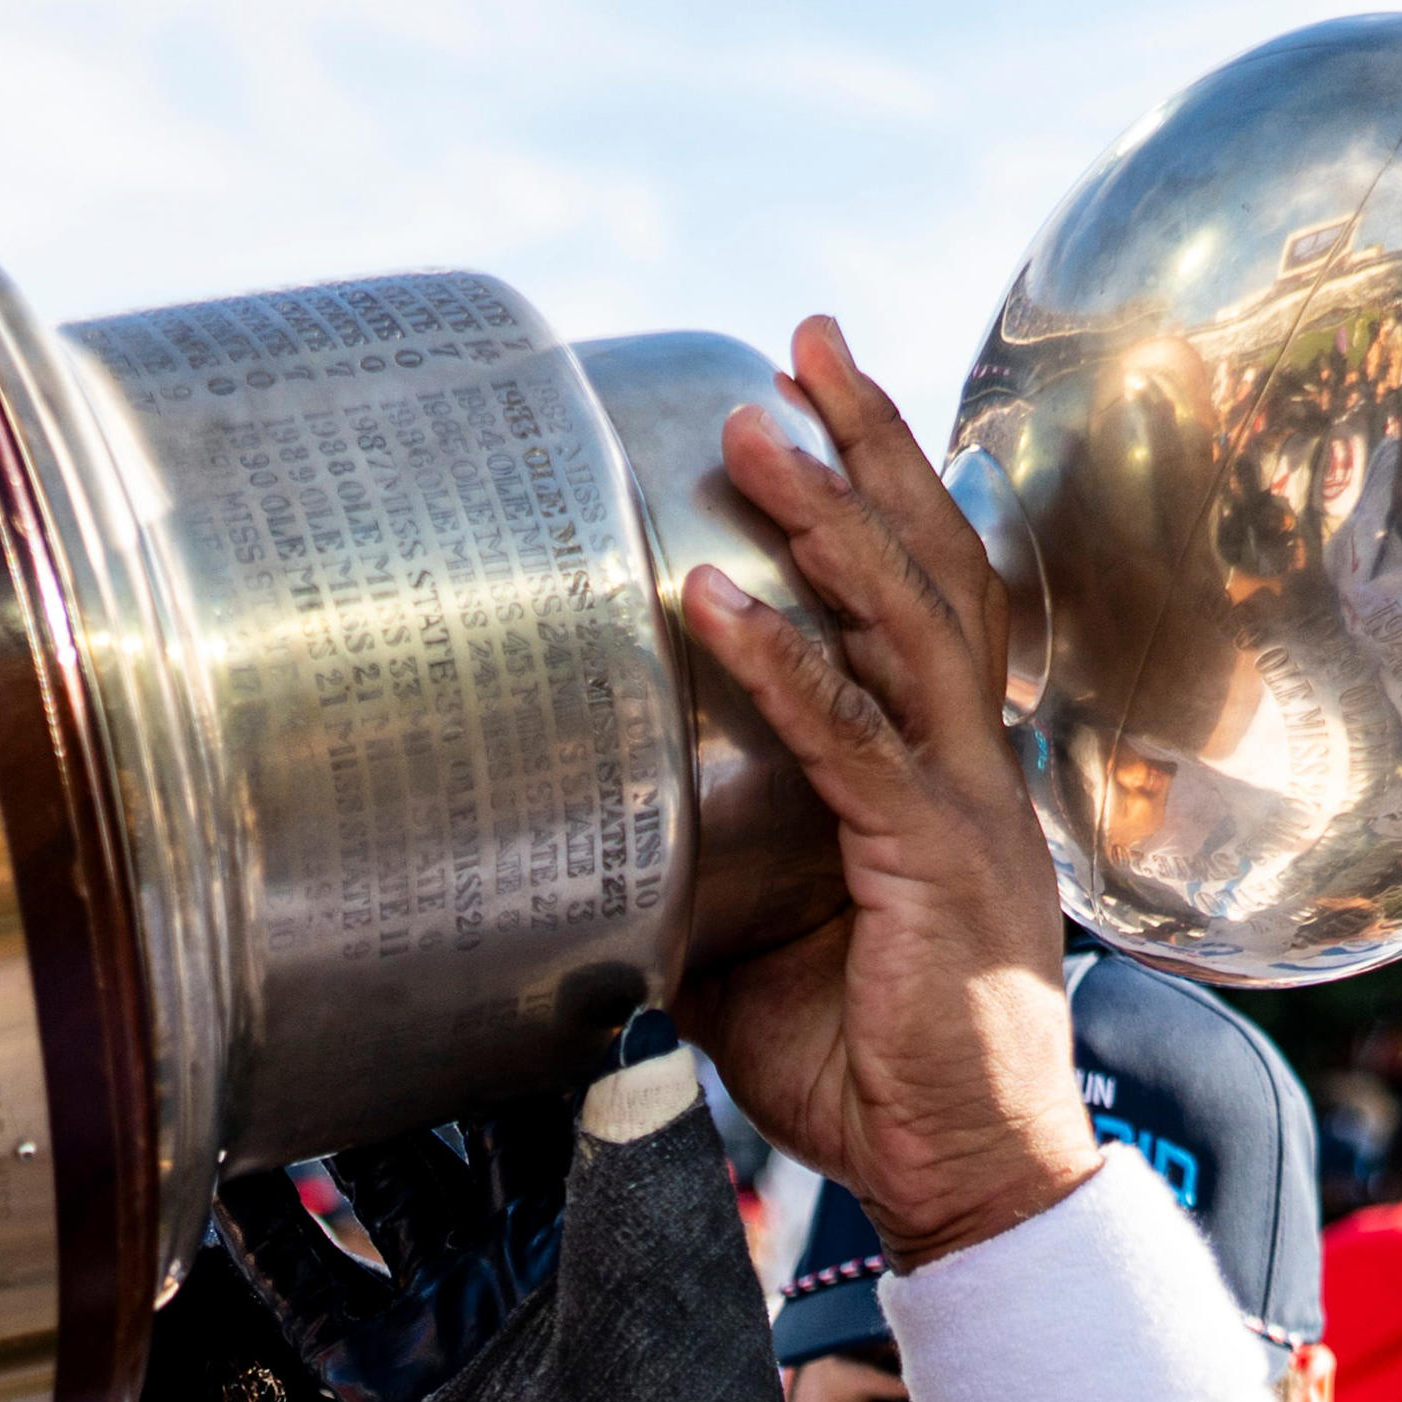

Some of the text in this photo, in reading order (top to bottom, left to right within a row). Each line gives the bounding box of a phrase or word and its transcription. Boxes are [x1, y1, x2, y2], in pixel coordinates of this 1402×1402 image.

[243, 371, 277, 389] 0
[323, 364, 356, 381] 7
[357, 356, 387, 372] 0
[392, 350, 425, 367] 0
[427, 345, 462, 363] 7
[500, 338, 534, 355] 7
[204, 377, 239, 395] 0
[216, 490, 266, 565] MISS
[302, 410, 357, 477] 1988
[335, 478, 383, 546] OLE
[361, 550, 412, 647] MISS
[411, 466, 459, 534] OLE
[260, 416, 318, 484] 1989
[297, 486, 344, 555] OLE
[322, 558, 375, 655] MISS
[353, 662, 384, 703] 21
[342, 404, 398, 472] 1987
[372, 469, 426, 562] MISS
[406, 568, 459, 684] STATE
[415, 390, 469, 456] 1985
[448, 458, 495, 526] OLE
[473, 527, 524, 624] MISS
[525, 778, 559, 887] STATE
[451, 384, 506, 450] 1984
[485, 451, 533, 522] OLE
[510, 523, 564, 617] MISS
[561, 771, 596, 877] STATE
[520, 446, 567, 519] OLE
[547, 521, 596, 612] MISS
[594, 758, 628, 870] STATE
[259, 492, 306, 561] OLE
[284, 564, 338, 661] MISS
[314, 666, 348, 708] 21
[337, 818, 372, 931] STATE
[1249, 640, 1315, 713] OLE
[1282, 696, 1333, 787] MISS
[636, 874, 662, 910] 10
